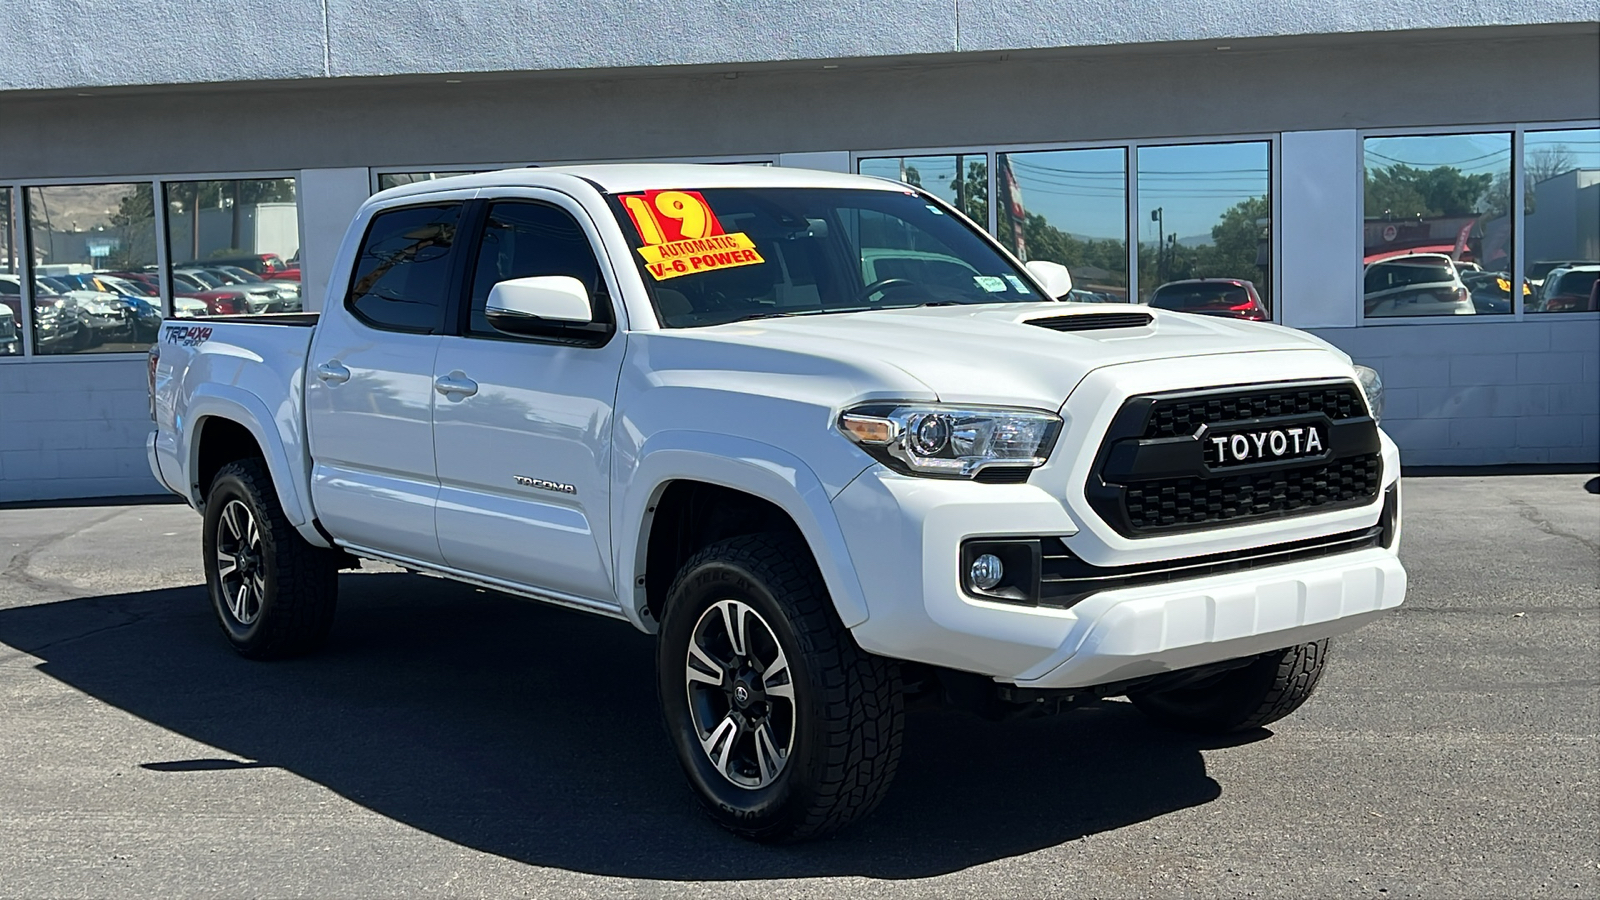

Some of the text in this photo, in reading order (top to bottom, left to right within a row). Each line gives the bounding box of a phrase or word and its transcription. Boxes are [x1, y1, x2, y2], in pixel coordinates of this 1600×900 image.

[625, 191, 712, 245] 19
[658, 235, 739, 259] AUTOMATIC
[648, 249, 757, 277] V-6 POWER
[182, 339, 205, 347] SPORT
[1211, 426, 1322, 463] TOYOTA
[513, 474, 577, 495] TACOMA
